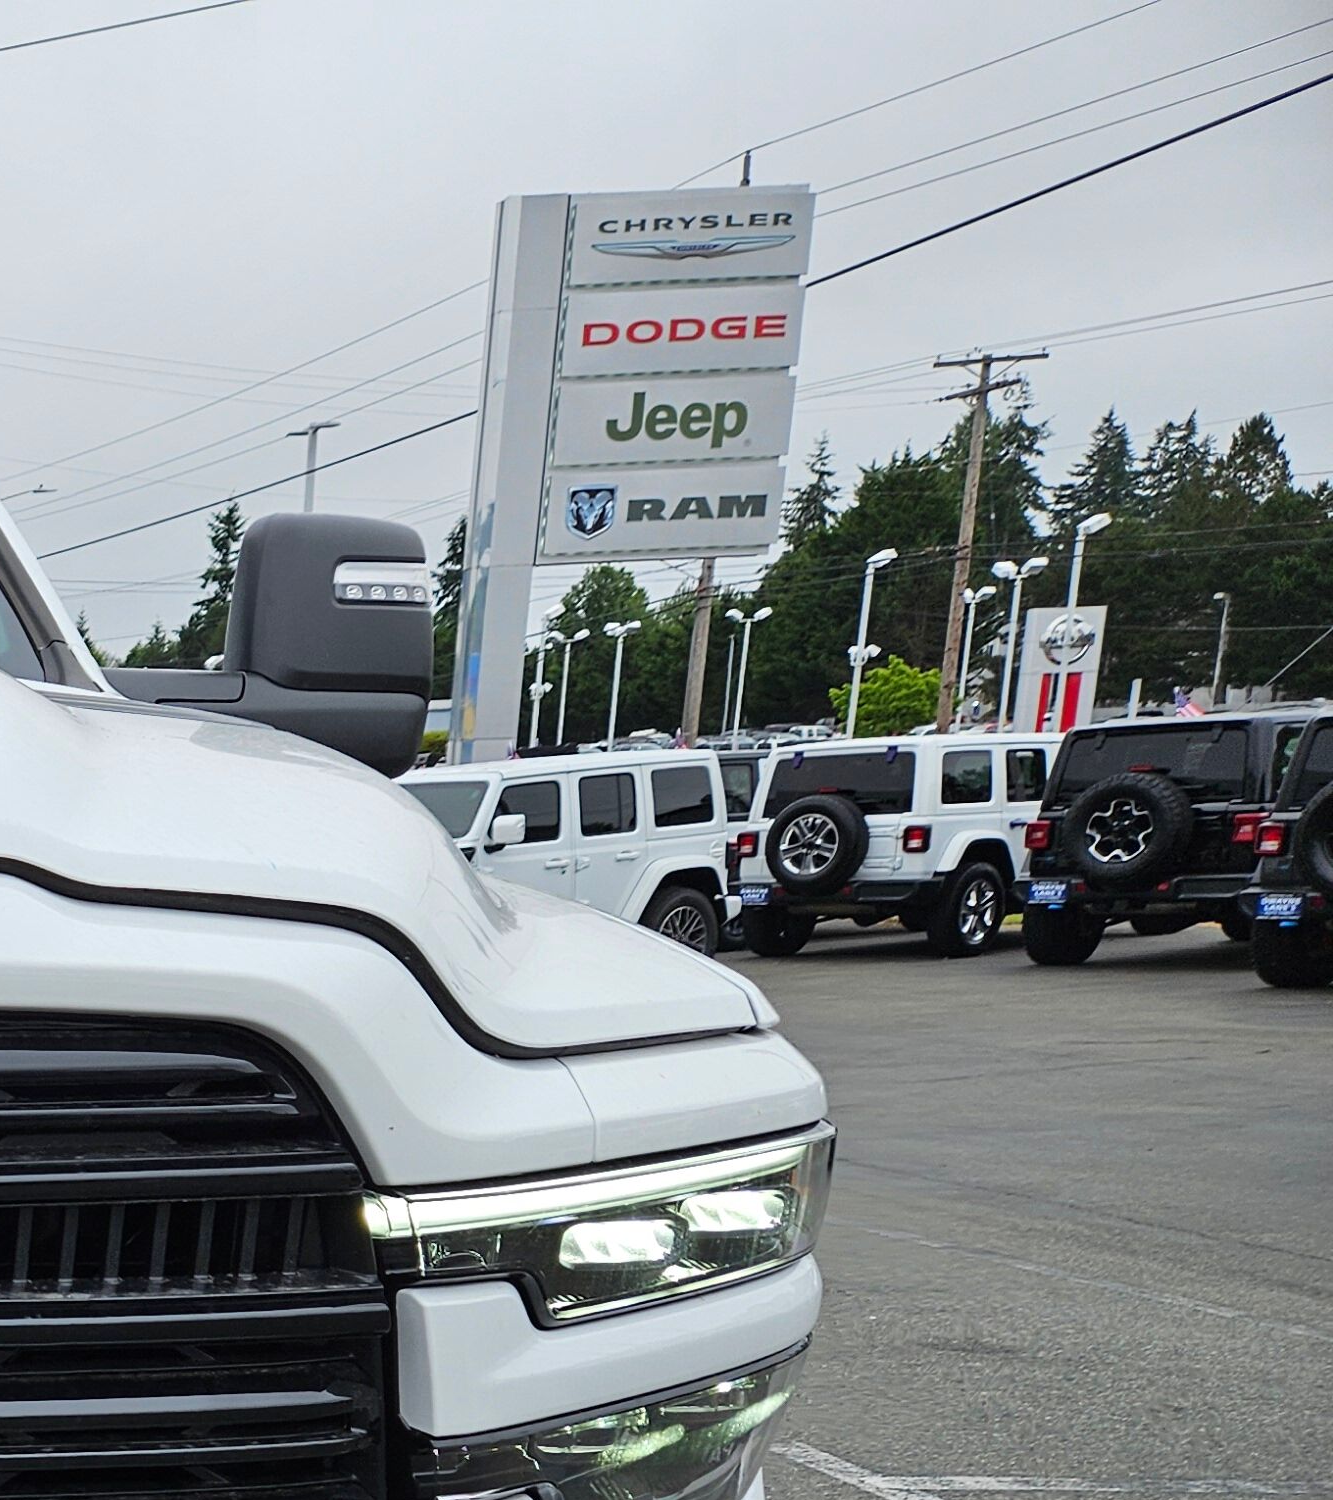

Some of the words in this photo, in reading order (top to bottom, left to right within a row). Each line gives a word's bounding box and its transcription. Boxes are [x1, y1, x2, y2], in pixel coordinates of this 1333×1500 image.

[598, 212, 793, 233] CHRYSLER
[582, 314, 788, 347] DODGE
[606, 392, 748, 448] Jeep
[626, 494, 768, 522] RAM
